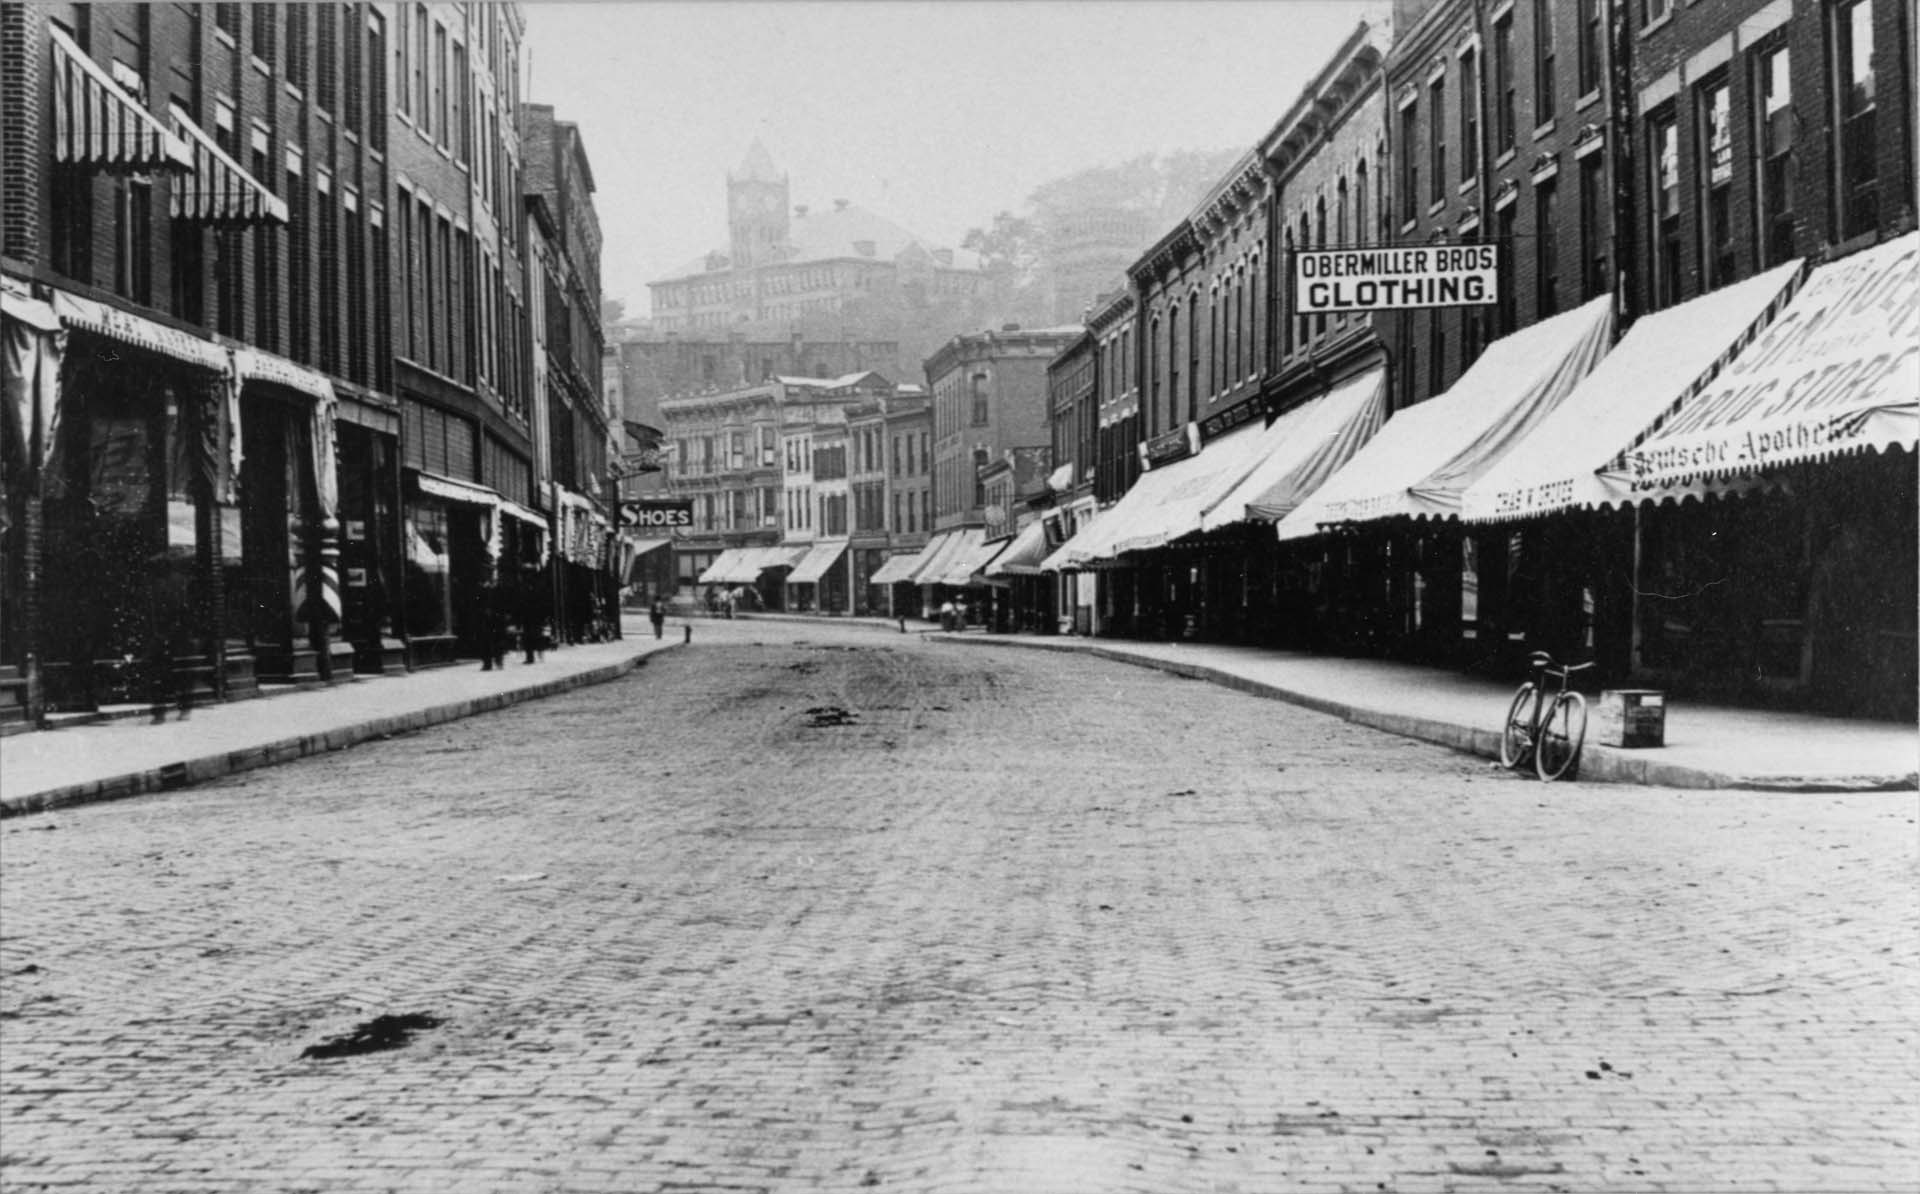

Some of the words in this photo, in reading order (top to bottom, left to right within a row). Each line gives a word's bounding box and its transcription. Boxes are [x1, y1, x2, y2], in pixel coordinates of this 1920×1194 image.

[1302, 251, 1428, 278] OBERMILLER
[1436, 247, 1497, 272] BROS.
[1309, 275, 1494, 308] CLOTHING.
[1655, 378, 1780, 440] DRUG
[1761, 346, 1919, 419] STORE
[619, 503, 689, 526] SHOES
